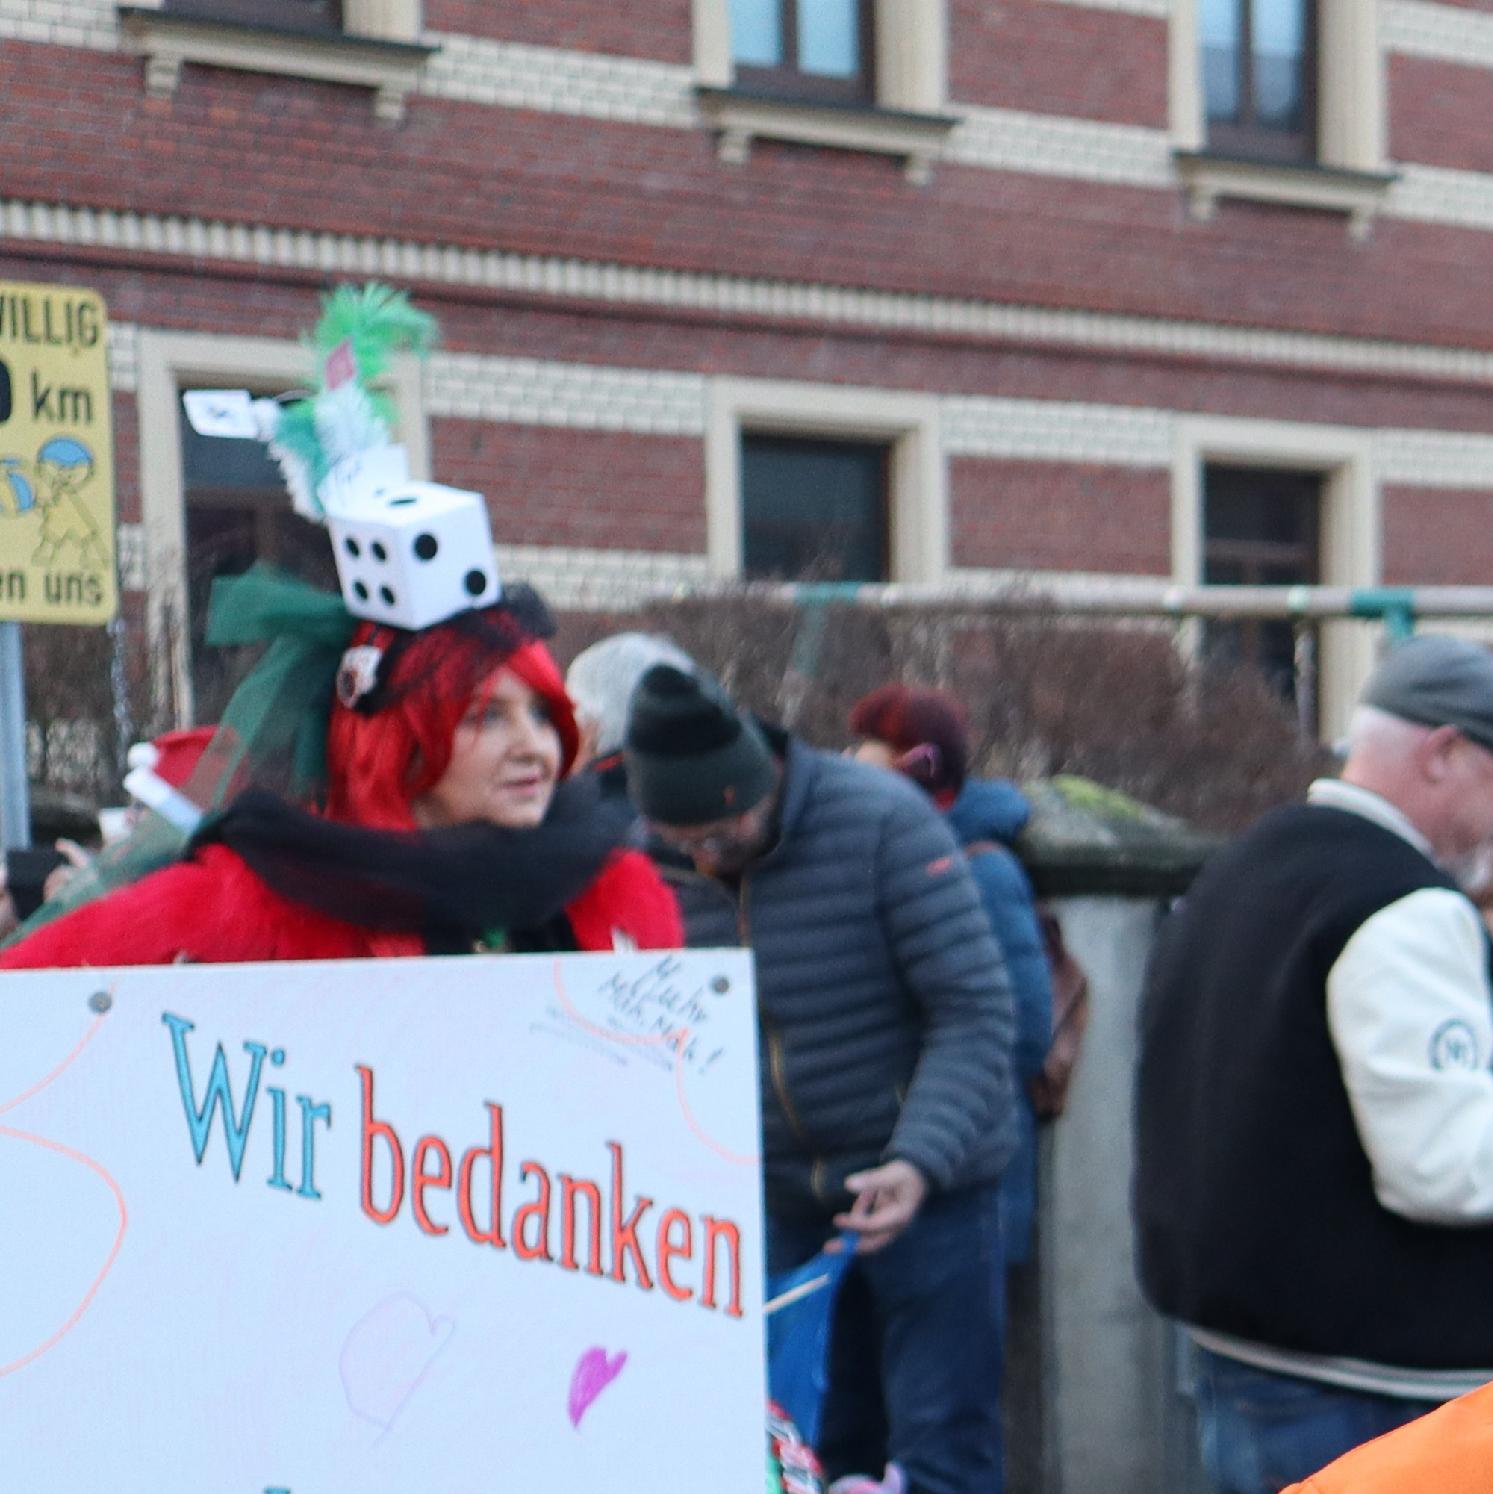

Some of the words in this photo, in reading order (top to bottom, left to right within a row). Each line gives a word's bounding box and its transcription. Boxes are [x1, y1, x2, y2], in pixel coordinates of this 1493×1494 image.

[0, 296, 98, 347] ILLIG
[32, 368, 93, 424] km
[45, 571, 104, 605] uns
[162, 1010, 333, 1200] Wir
[355, 1063, 744, 1318] bedanken
